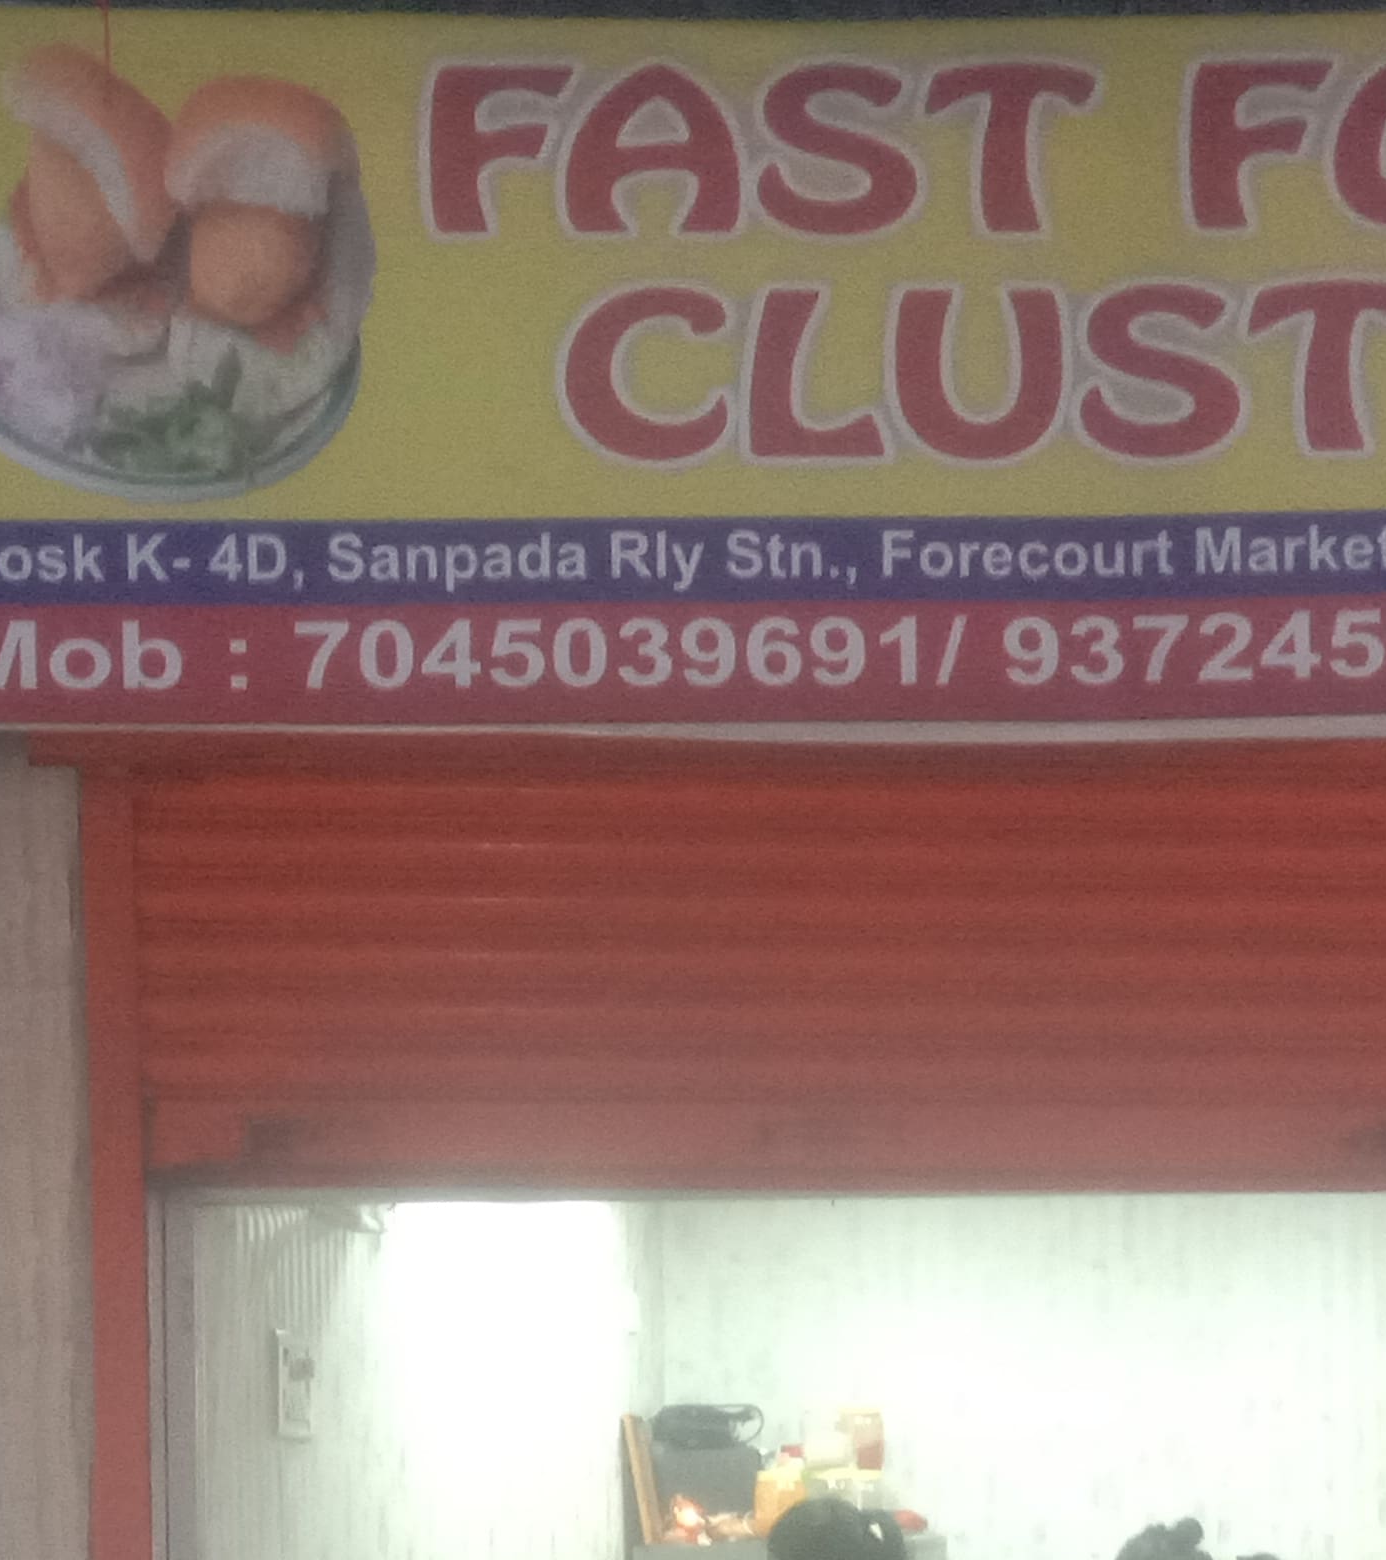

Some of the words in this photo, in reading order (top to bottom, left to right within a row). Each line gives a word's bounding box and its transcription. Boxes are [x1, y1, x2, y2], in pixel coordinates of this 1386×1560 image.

[423, 55, 1101, 240] FAST
[208, 533, 304, 591] 4D,
[327, 531, 588, 592] Sanpada
[610, 529, 704, 592] Rly
[727, 529, 858, 586] Stn.,
[882, 527, 1174, 580] Forecourt
[293, 612, 968, 690] 7045039691/
